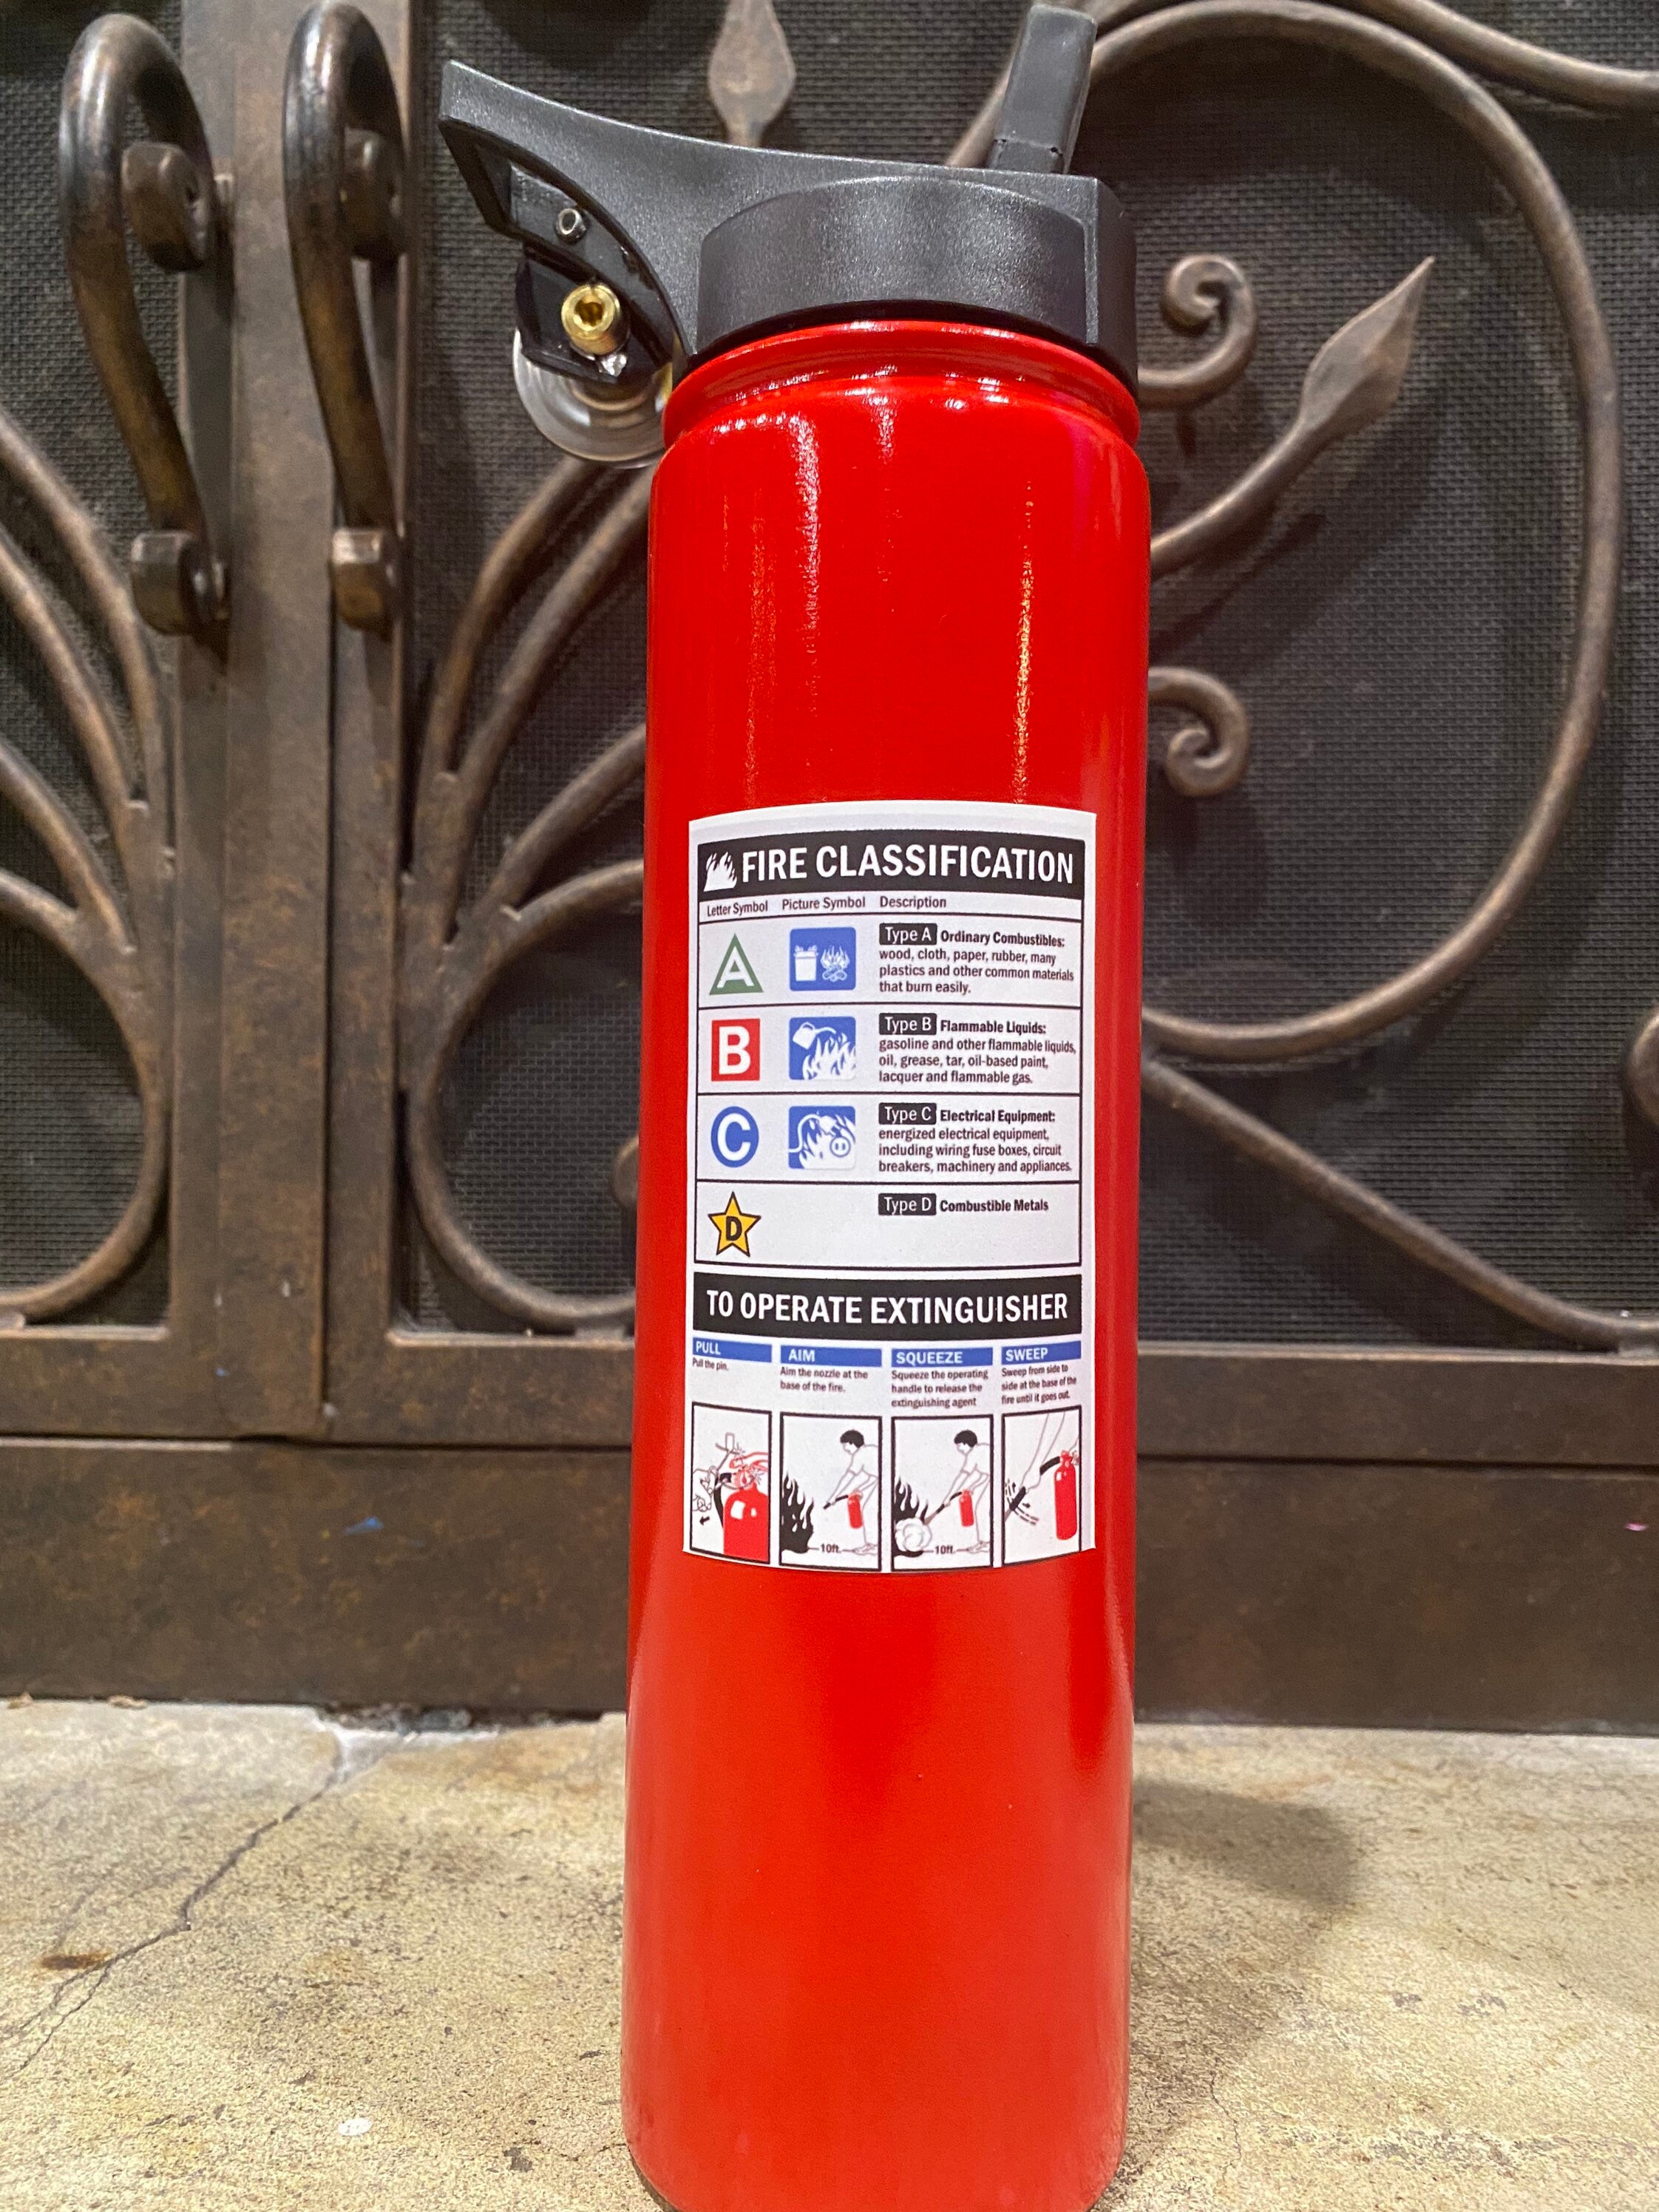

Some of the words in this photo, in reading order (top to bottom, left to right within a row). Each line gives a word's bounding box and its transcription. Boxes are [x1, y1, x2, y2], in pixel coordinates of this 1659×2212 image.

[742, 847, 807, 883] FIRE
[815, 844, 1073, 884] CLASSIFICATION
[707, 905, 730, 917] Letter
[733, 900, 768, 916] Symbol
[782, 898, 820, 910] Picture
[823, 896, 866, 909] Symbol
[880, 895, 946, 909] Description
[885, 926, 918, 944] Type
[921, 927, 932, 941] A
[940, 930, 990, 945] Ordinary
[993, 932, 1065, 947] Combustibles:
[879, 949, 915, 960] wood,
[917, 948, 950, 961] cloth,
[954, 950, 988, 963] paper,
[991, 949, 1028, 963] rubber,
[1031, 953, 1056, 966] many
[716, 948, 754, 988] A
[879, 965, 925, 978] plastics
[929, 966, 950, 976] and
[953, 966, 983, 977] other
[985, 968, 1030, 978] common
[1032, 969, 1073, 981] materials
[879, 981, 903, 991] that
[906, 981, 932, 992] burn
[935, 982, 971, 995] easily.
[884, 1016, 917, 1034] Type
[923, 1017, 932, 1031] B
[940, 1020, 1003, 1033] Flammable
[1006, 1021, 1046, 1036] Liquids:
[719, 1025, 751, 1074] B
[879, 1038, 929, 1052] gasoline
[932, 1039, 954, 1050] and
[956, 1039, 985, 1051] other
[988, 1039, 1042, 1051] flammable
[1045, 1040, 1076, 1054] liquids,
[879, 1054, 898, 1067] oil,
[900, 1056, 943, 1068] grease,
[946, 1056, 966, 1068] tar,
[968, 1056, 1018, 1067] oil-based
[1021, 1056, 1048, 1069] paint,
[879, 1071, 923, 1084] lacquer
[926, 1071, 947, 1082] and
[951, 1071, 1010, 1083] flammable
[1012, 1073, 1033, 1085] gas.
[884, 1106, 917, 1124] Type
[921, 1107, 932, 1121] C
[940, 1110, 995, 1122] Electrical
[998, 1110, 1055, 1124] Equipment:
[717, 1113, 751, 1161] C
[879, 1128, 935, 1141] energized
[939, 1127, 990, 1139] electrical
[993, 1129, 1049, 1141] equipment,
[879, 1144, 933, 1158] including
[935, 1144, 970, 1158] wiring
[972, 1144, 995, 1156] fuse
[998, 1144, 1030, 1157] boxes,
[1033, 1144, 1062, 1156] circuit
[879, 1160, 933, 1173] breakers,
[937, 1161, 995, 1174] machinery
[998, 1161, 1017, 1172] and
[1020, 1161, 1072, 1173] appliances.
[884, 1197, 917, 1215] Type
[922, 1198, 932, 1211] D
[940, 1200, 1011, 1212] Combustible
[1014, 1198, 1048, 1212] Metals
[725, 1216, 742, 1241] D
[706, 1289, 733, 1317] TO
[740, 1292, 863, 1324] OPERATE
[870, 1293, 1068, 1324] EXTINGUISHER
[696, 1340, 722, 1355] PULL
[788, 1348, 815, 1362] AIM
[896, 1351, 963, 1365] SQUEEZE
[1005, 1348, 1048, 1362] SWEEP
[693, 1357, 703, 1368] Pull
[705, 1360, 715, 1368] the
[716, 1361, 729, 1371] pin.
[1002, 1366, 1026, 1377] Sweep
[1028, 1365, 1045, 1375] from
[1047, 1365, 1060, 1374] side
[1062, 1363, 1068, 1372] to
[781, 1367, 796, 1377] Aim
[798, 1368, 812, 1377] the
[814, 1369, 841, 1378] nozzle
[854, 1369, 868, 1379] the
[892, 1370, 929, 1380] Squeeze
[931, 1370, 946, 1379] the
[948, 1370, 988, 1380] operating
[781, 1380, 800, 1391] base
[802, 1382, 811, 1391] of
[812, 1382, 826, 1391] the
[828, 1382, 846, 1393] fire.
[892, 1384, 922, 1393] handle
[924, 1385, 933, 1393] to
[935, 1383, 967, 1393] release
[969, 1383, 982, 1392] the
[1002, 1380, 1018, 1391] side
[1020, 1380, 1027, 1389] at
[1028, 1380, 1040, 1388] the
[1042, 1377, 1058, 1388] base
[1059, 1377, 1065, 1385] of
[1068, 1376, 1076, 1385] the
[892, 1397, 950, 1408] extinguishing
[952, 1397, 977, 1408] agent
[1002, 1394, 1014, 1404] fire
[1016, 1394, 1033, 1403] until
[1034, 1393, 1039, 1402] it
[1041, 1393, 1057, 1403] goes
[1059, 1390, 1071, 1400] out.
